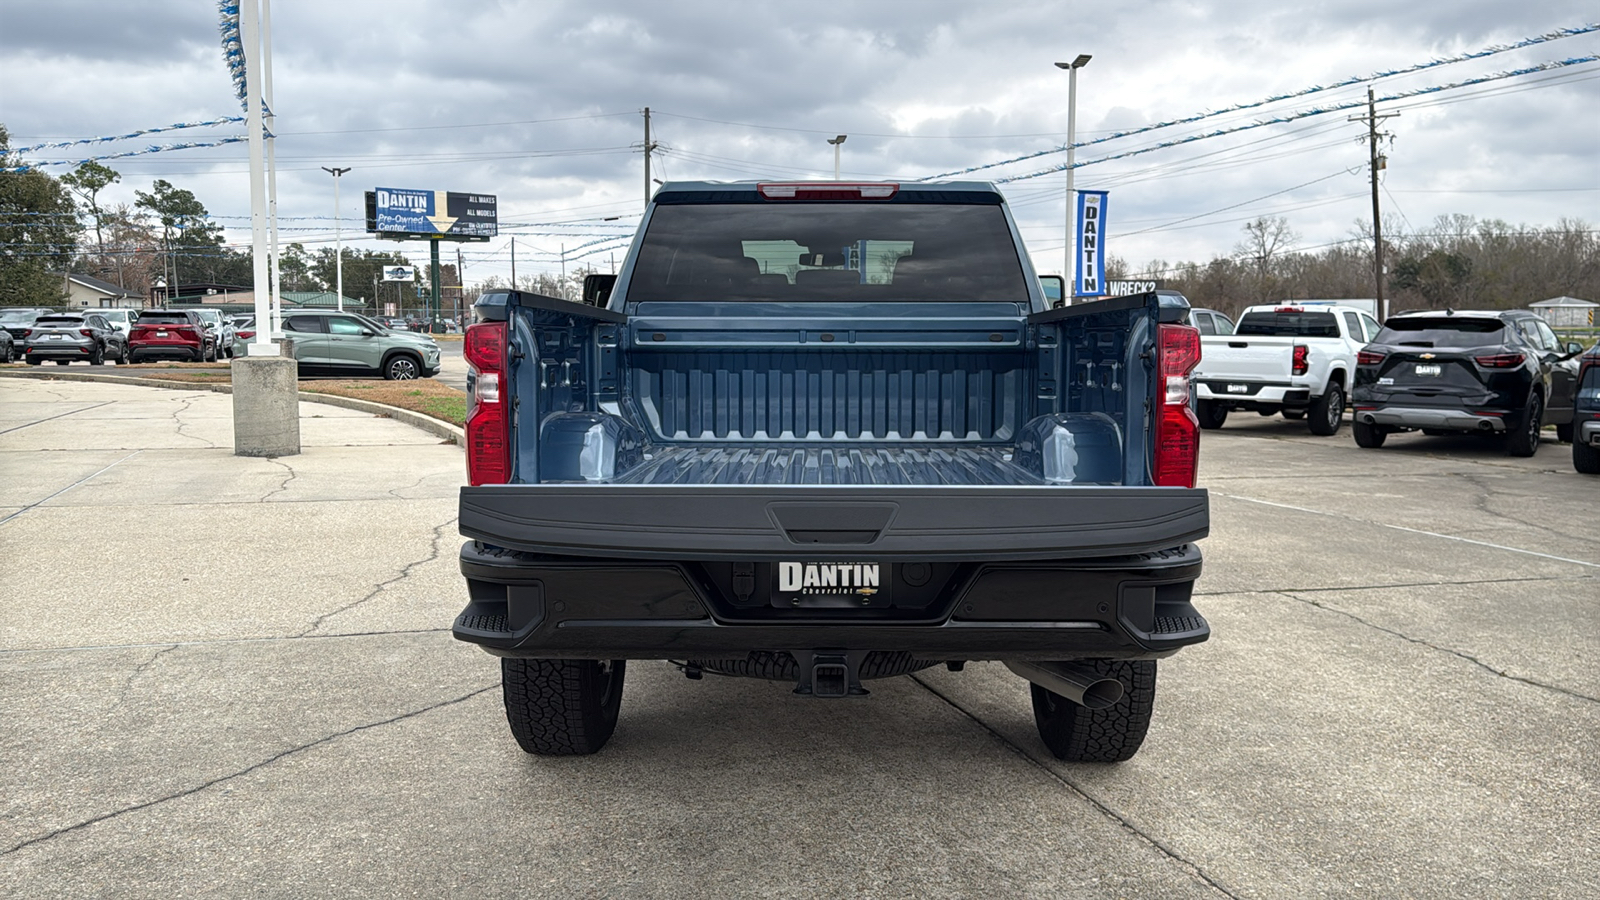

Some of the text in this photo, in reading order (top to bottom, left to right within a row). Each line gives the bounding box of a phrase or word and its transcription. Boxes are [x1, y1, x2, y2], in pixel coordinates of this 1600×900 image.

[378, 191, 427, 208] DANTIN
[469, 195, 495, 204] ALL MAKES
[467, 208, 495, 217] ALL MODELS
[378, 213, 423, 224] Pre-Owned
[378, 222, 407, 231] Center
[1084, 206, 1097, 291] DANTIN
[779, 562, 879, 591] DANTIN
[802, 587, 853, 595] Chevrolet
